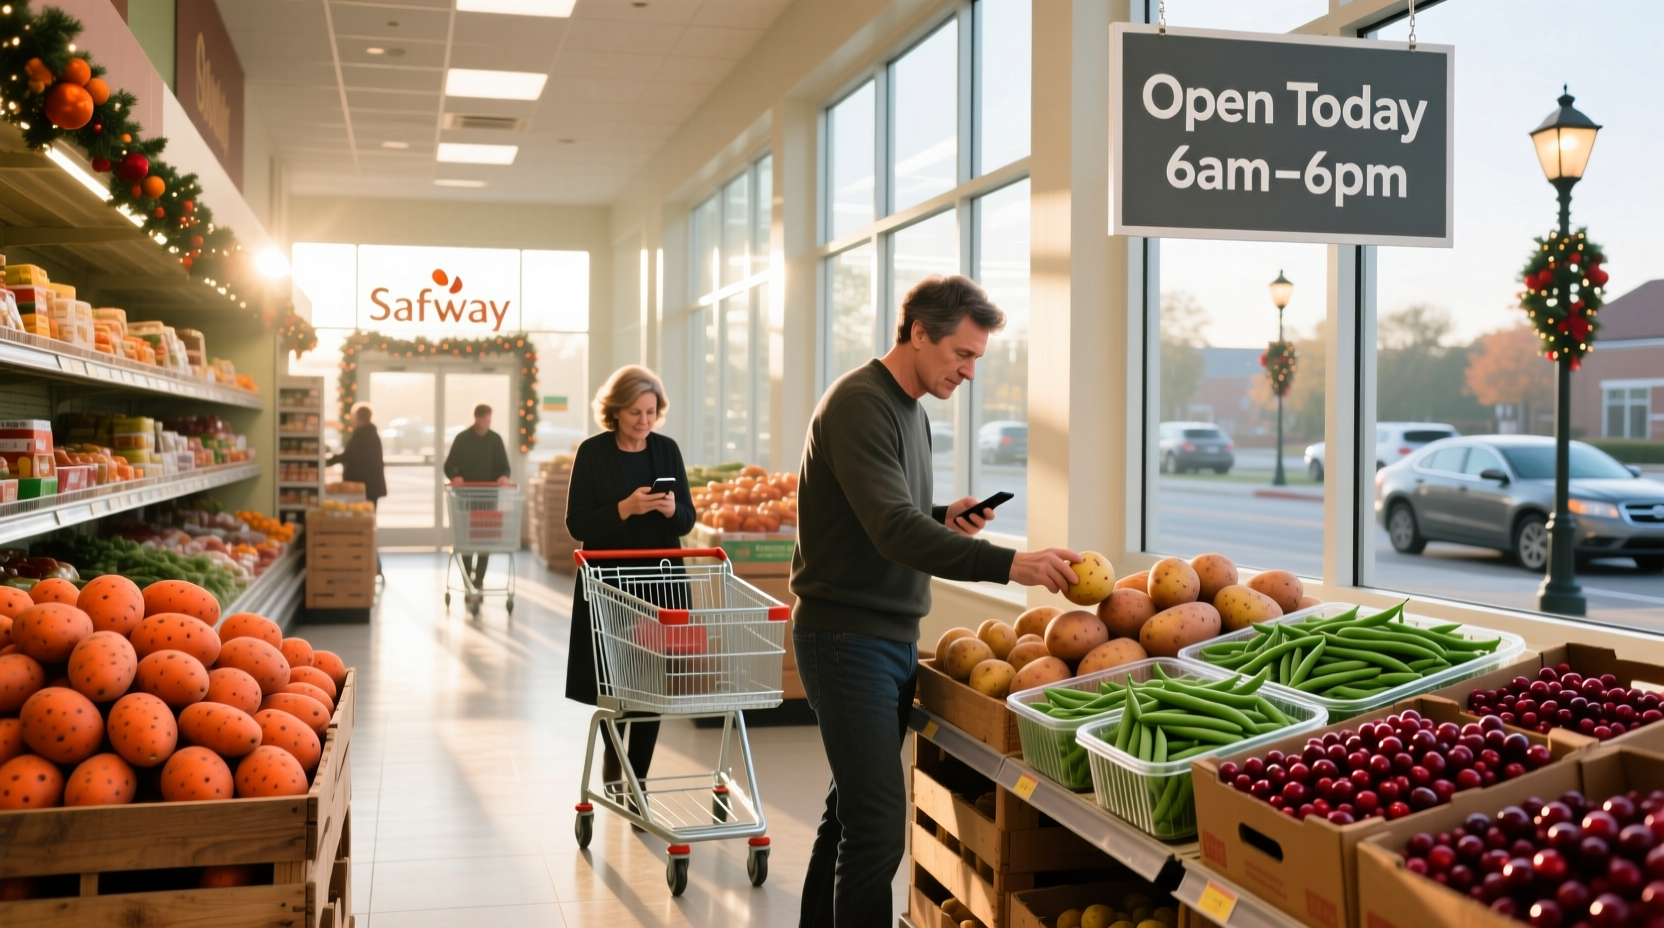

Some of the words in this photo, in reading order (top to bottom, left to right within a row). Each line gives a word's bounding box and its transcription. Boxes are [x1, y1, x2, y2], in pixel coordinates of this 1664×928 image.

[1142, 73, 1274, 132] Open
[1286, 81, 1428, 144] Today
[370, 287, 511, 332] Safway
